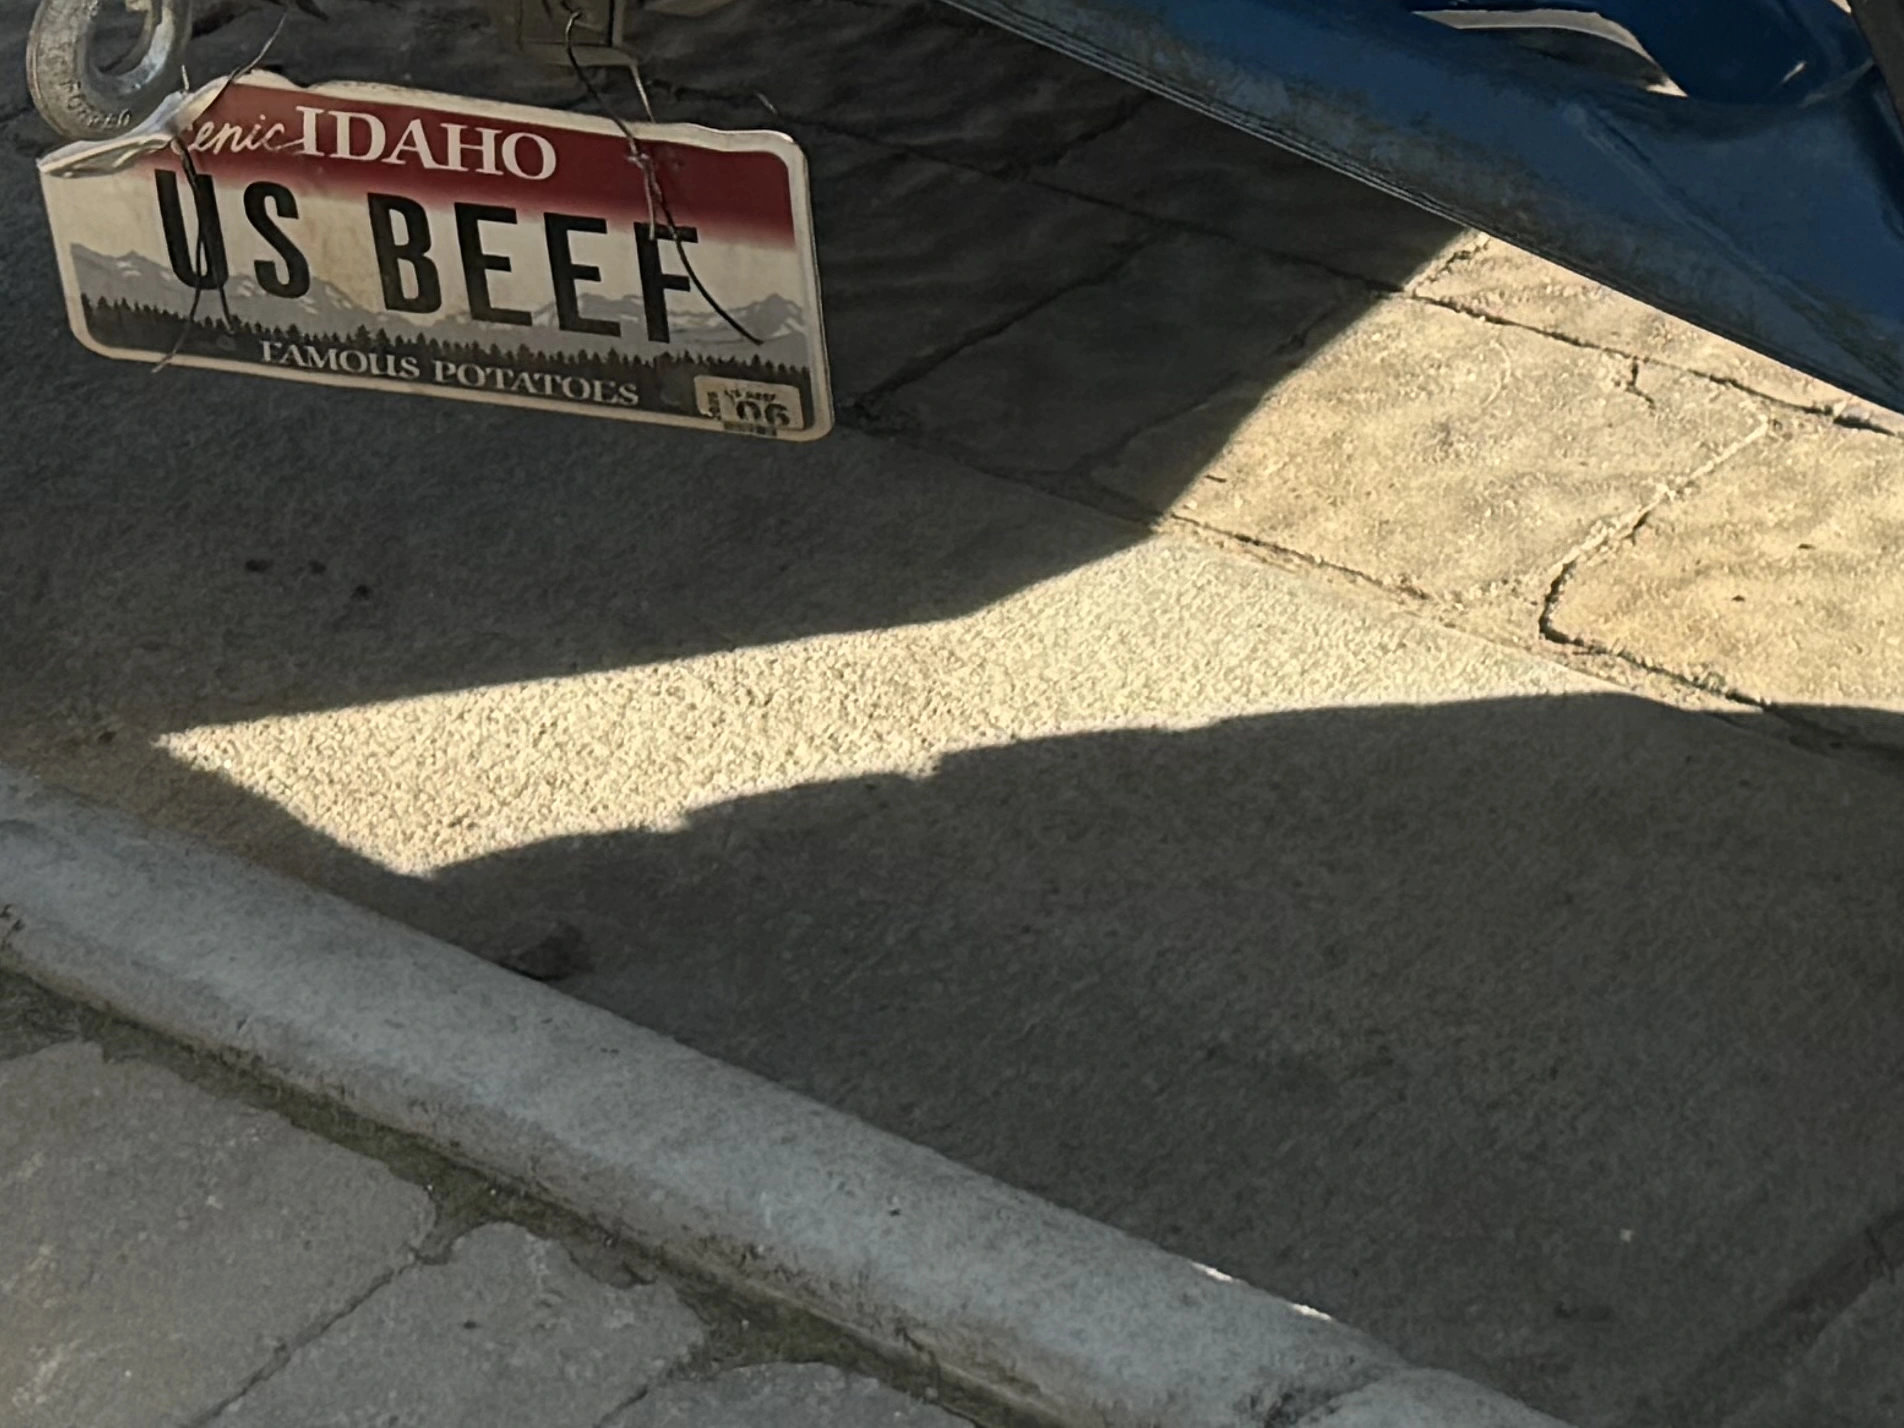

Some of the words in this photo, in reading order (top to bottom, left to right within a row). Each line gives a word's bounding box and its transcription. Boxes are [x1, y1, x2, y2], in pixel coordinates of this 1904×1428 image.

[184, 114, 299, 156] enic
[296, 104, 558, 181] IDAHO
[154, 168, 311, 299] US
[367, 191, 700, 344] BEEF
[261, 340, 421, 380] FAMOUS
[433, 358, 640, 407] POTATOES
